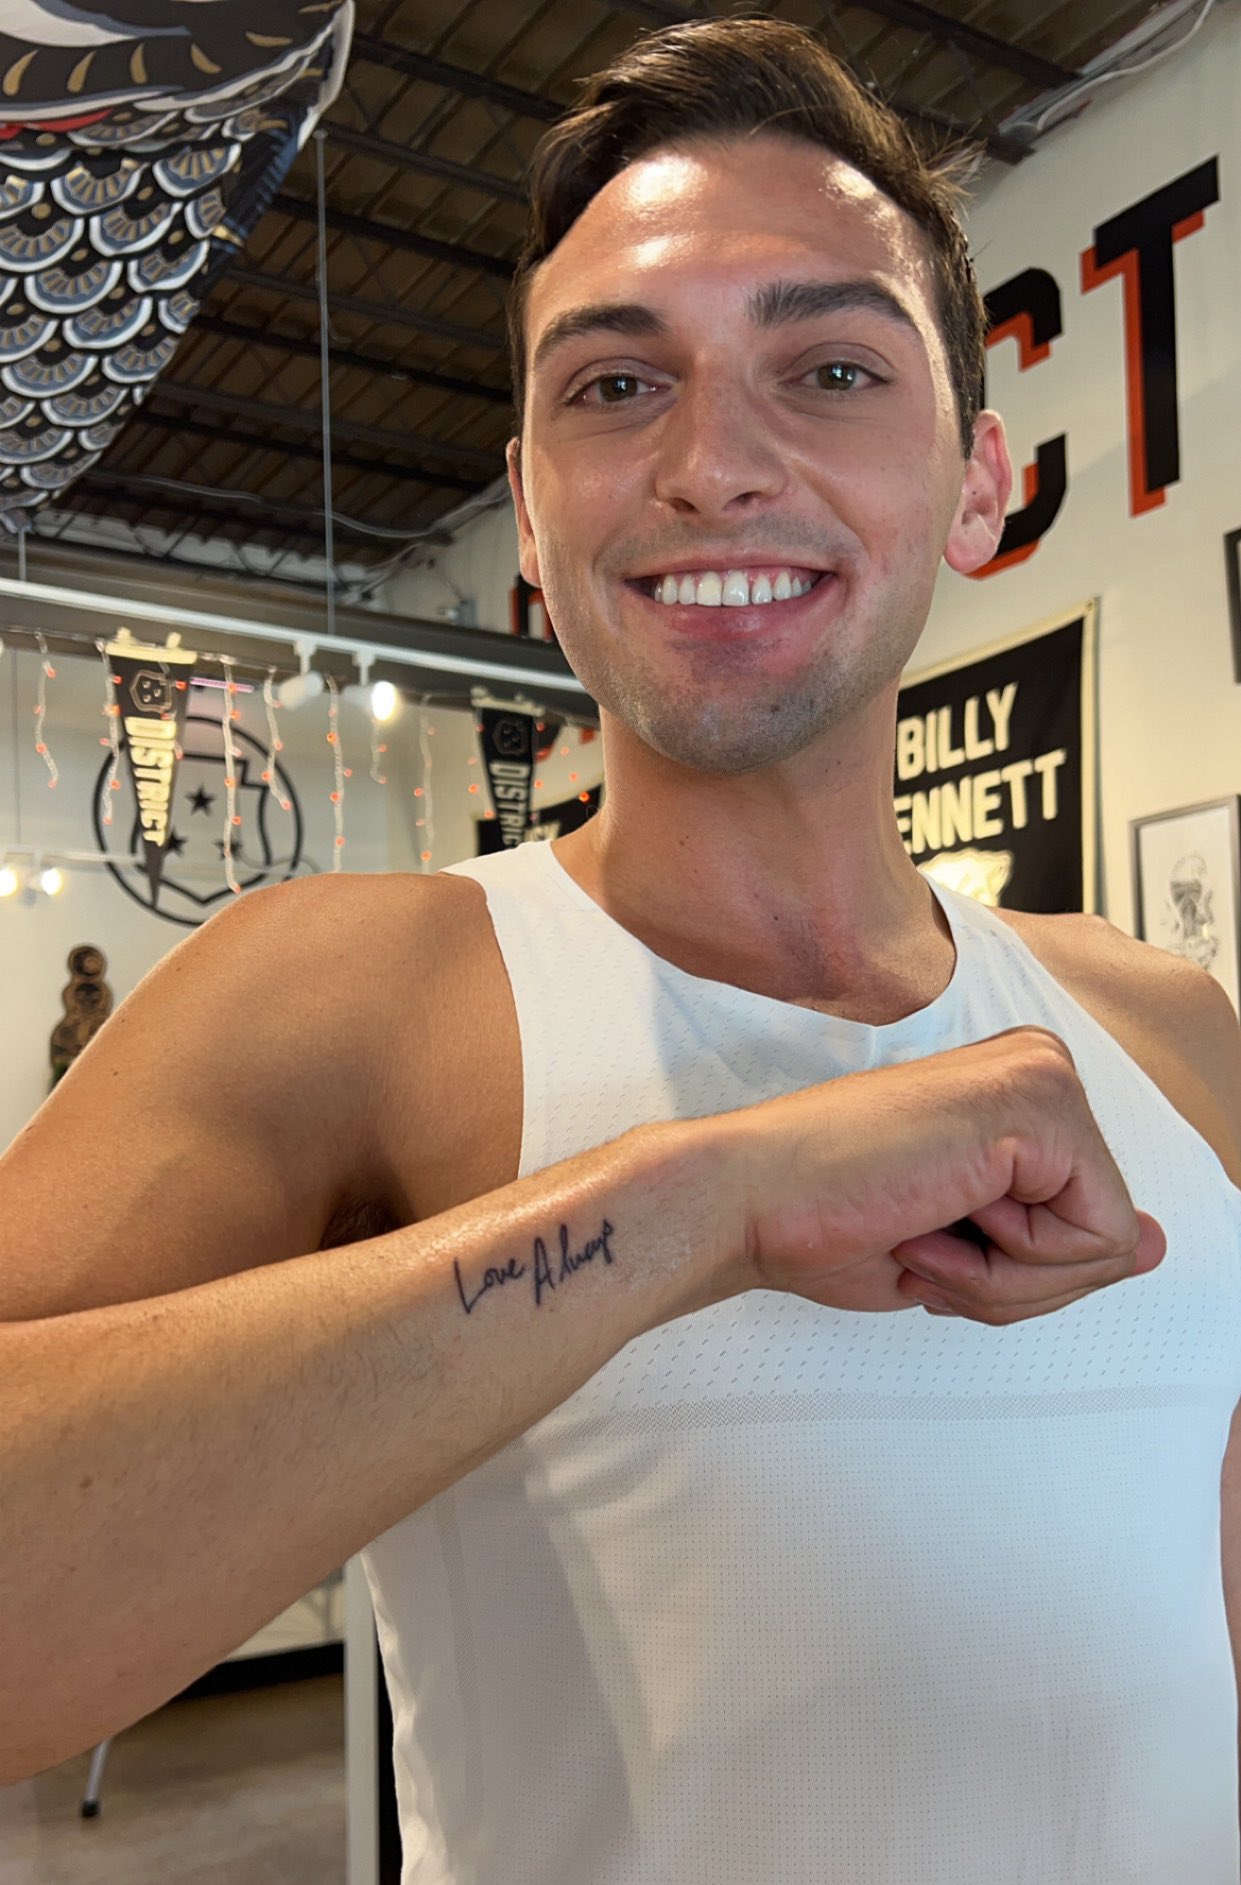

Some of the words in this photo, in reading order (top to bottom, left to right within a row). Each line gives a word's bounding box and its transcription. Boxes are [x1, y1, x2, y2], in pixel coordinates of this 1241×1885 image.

[896, 681, 1019, 781] BILLY
[123, 716, 178, 847] DISTRICT
[453, 1258, 526, 1314] Love
